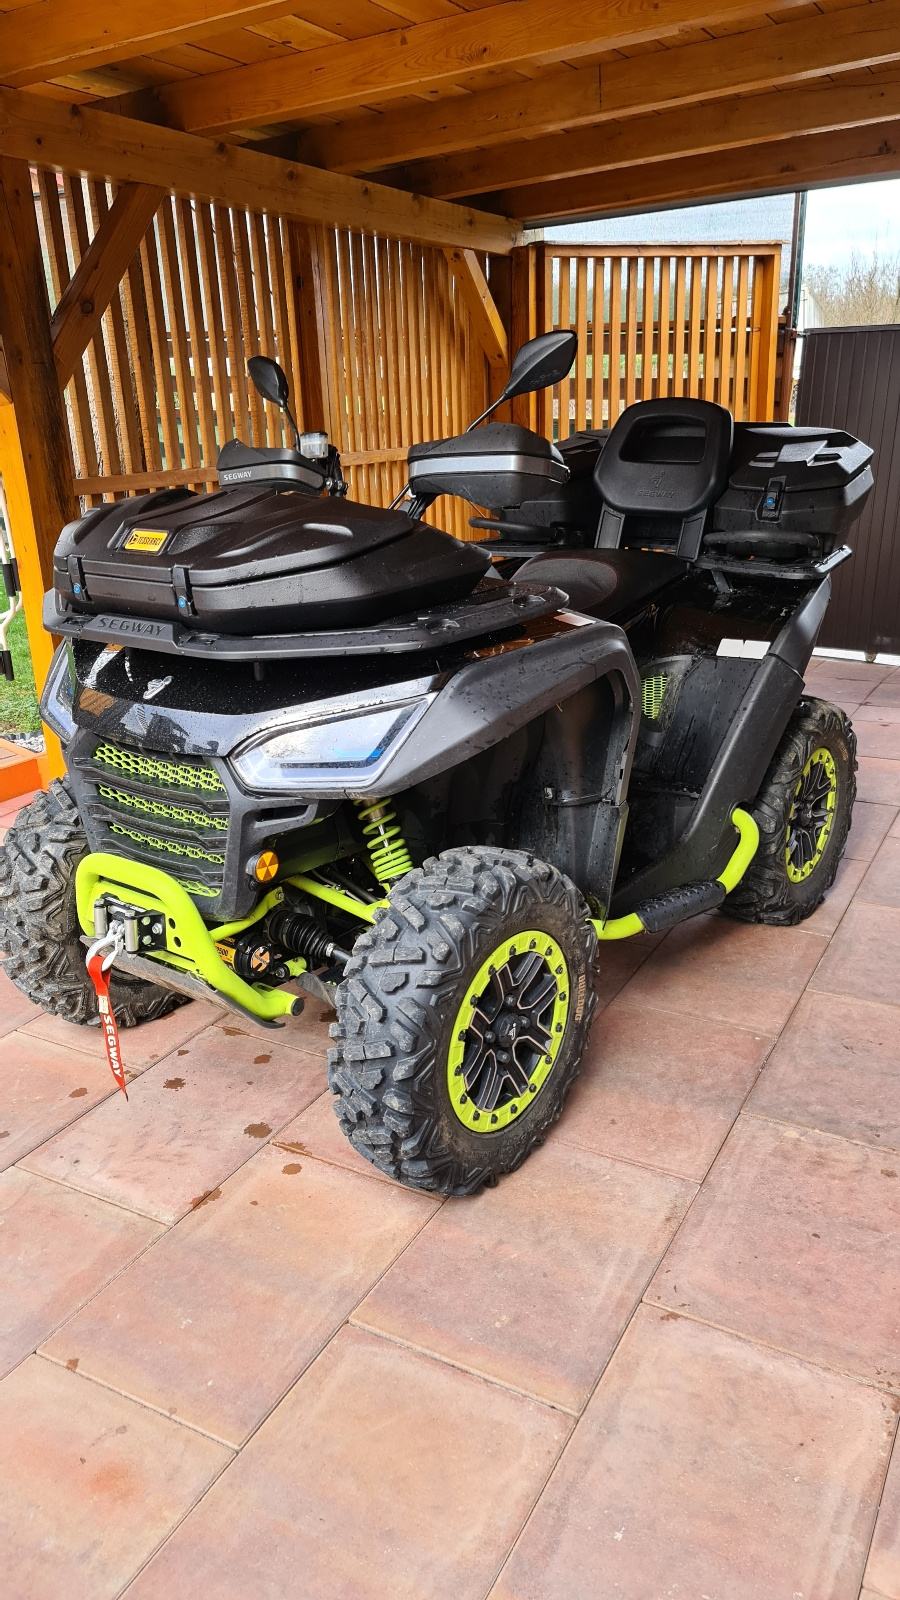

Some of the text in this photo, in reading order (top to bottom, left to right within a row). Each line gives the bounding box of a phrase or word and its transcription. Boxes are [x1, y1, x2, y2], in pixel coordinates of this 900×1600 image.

[223, 470, 252, 480] SEGWAY
[97, 617, 166, 636] SEGWAY
[103, 1014, 122, 1078] SEGWAY
